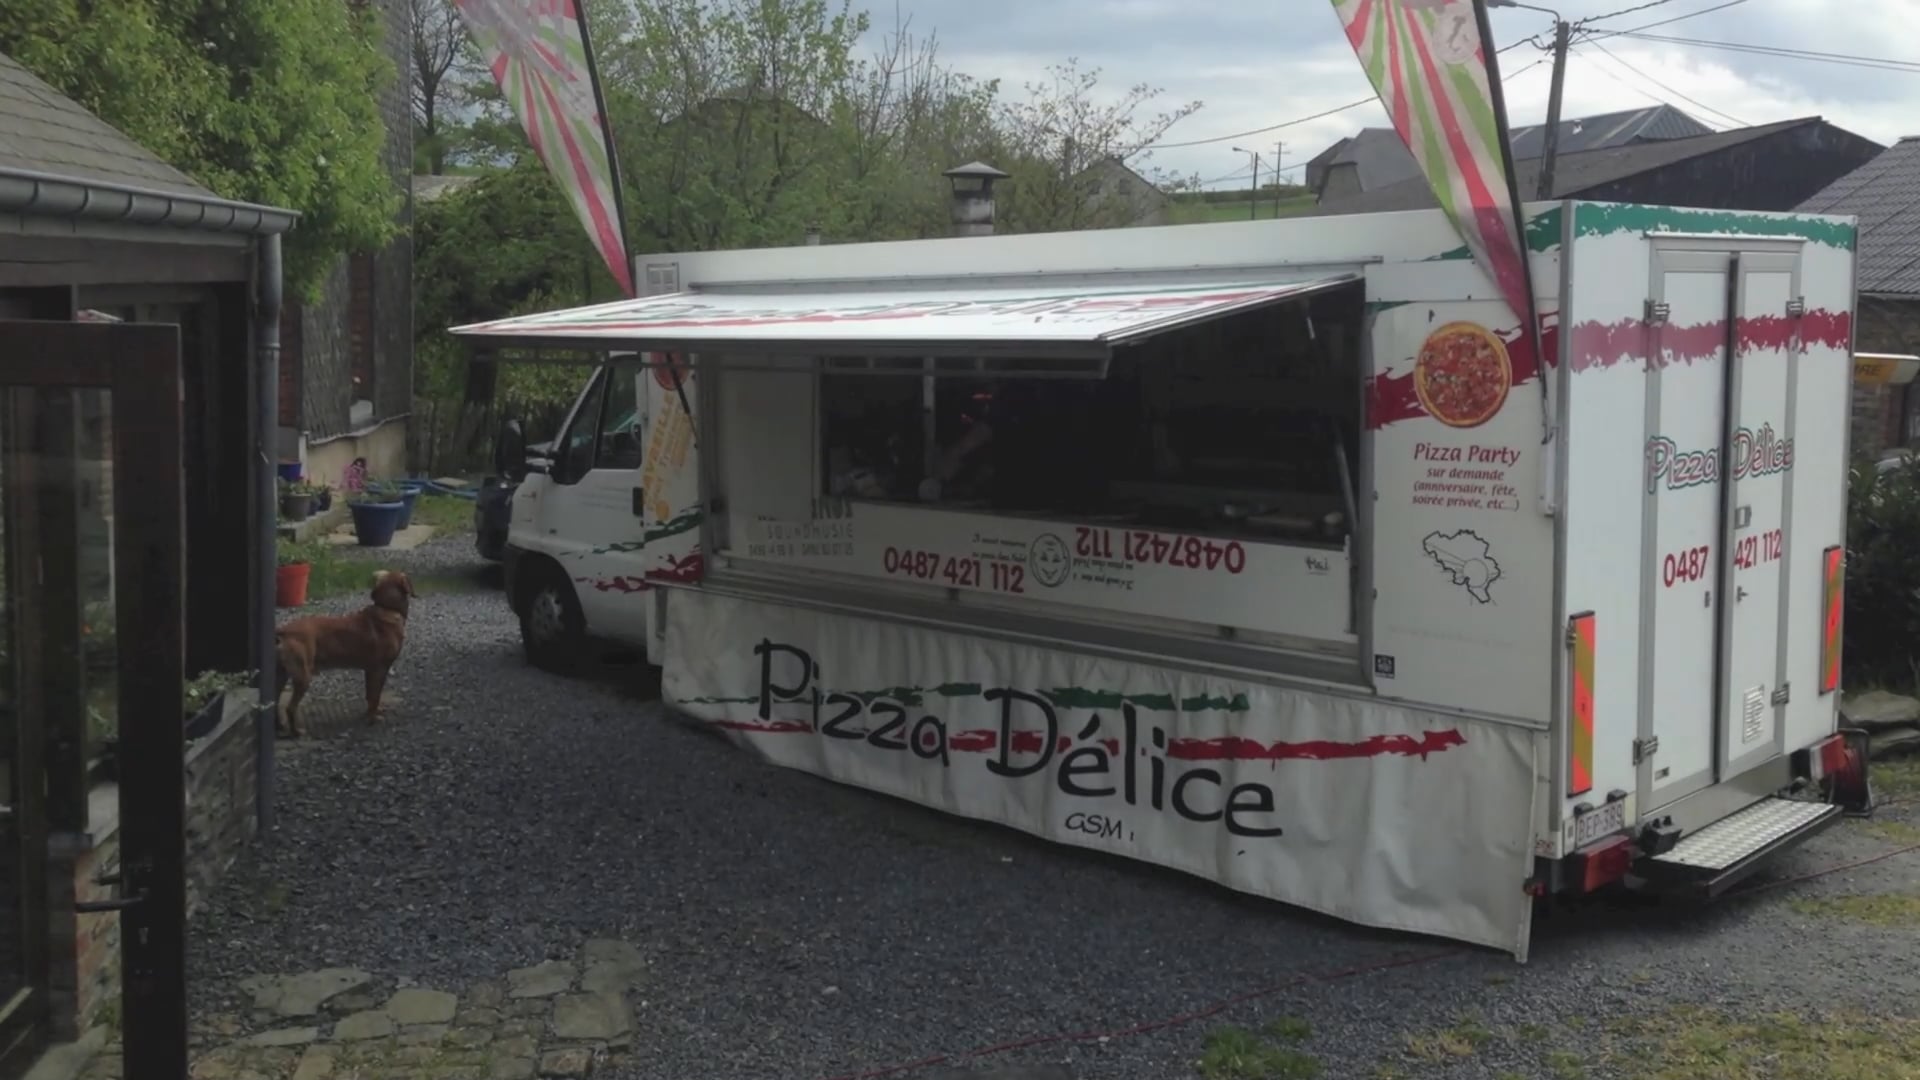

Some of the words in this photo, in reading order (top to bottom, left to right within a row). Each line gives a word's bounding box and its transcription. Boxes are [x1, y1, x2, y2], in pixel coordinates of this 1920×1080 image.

[1414, 442, 1462, 461] Pizza
[1467, 445, 1521, 467] Party
[1647, 436, 1720, 494] Pizza
[1733, 422, 1795, 481] Délice
[1426, 467, 1446, 479] sur
[1449, 468, 1504, 481] demande
[1412, 494, 1445, 505] soirée
[1076, 527, 1114, 557] 112
[1664, 546, 1709, 588] 0487
[1734, 536, 1758, 571] 421
[1763, 529, 1782, 562] 112
[884, 547, 940, 580] 0487
[944, 556, 980, 586] 421
[991, 562, 1025, 594] 112
[754, 637, 951, 769] Pizza
[984, 687, 1283, 838] Délice
